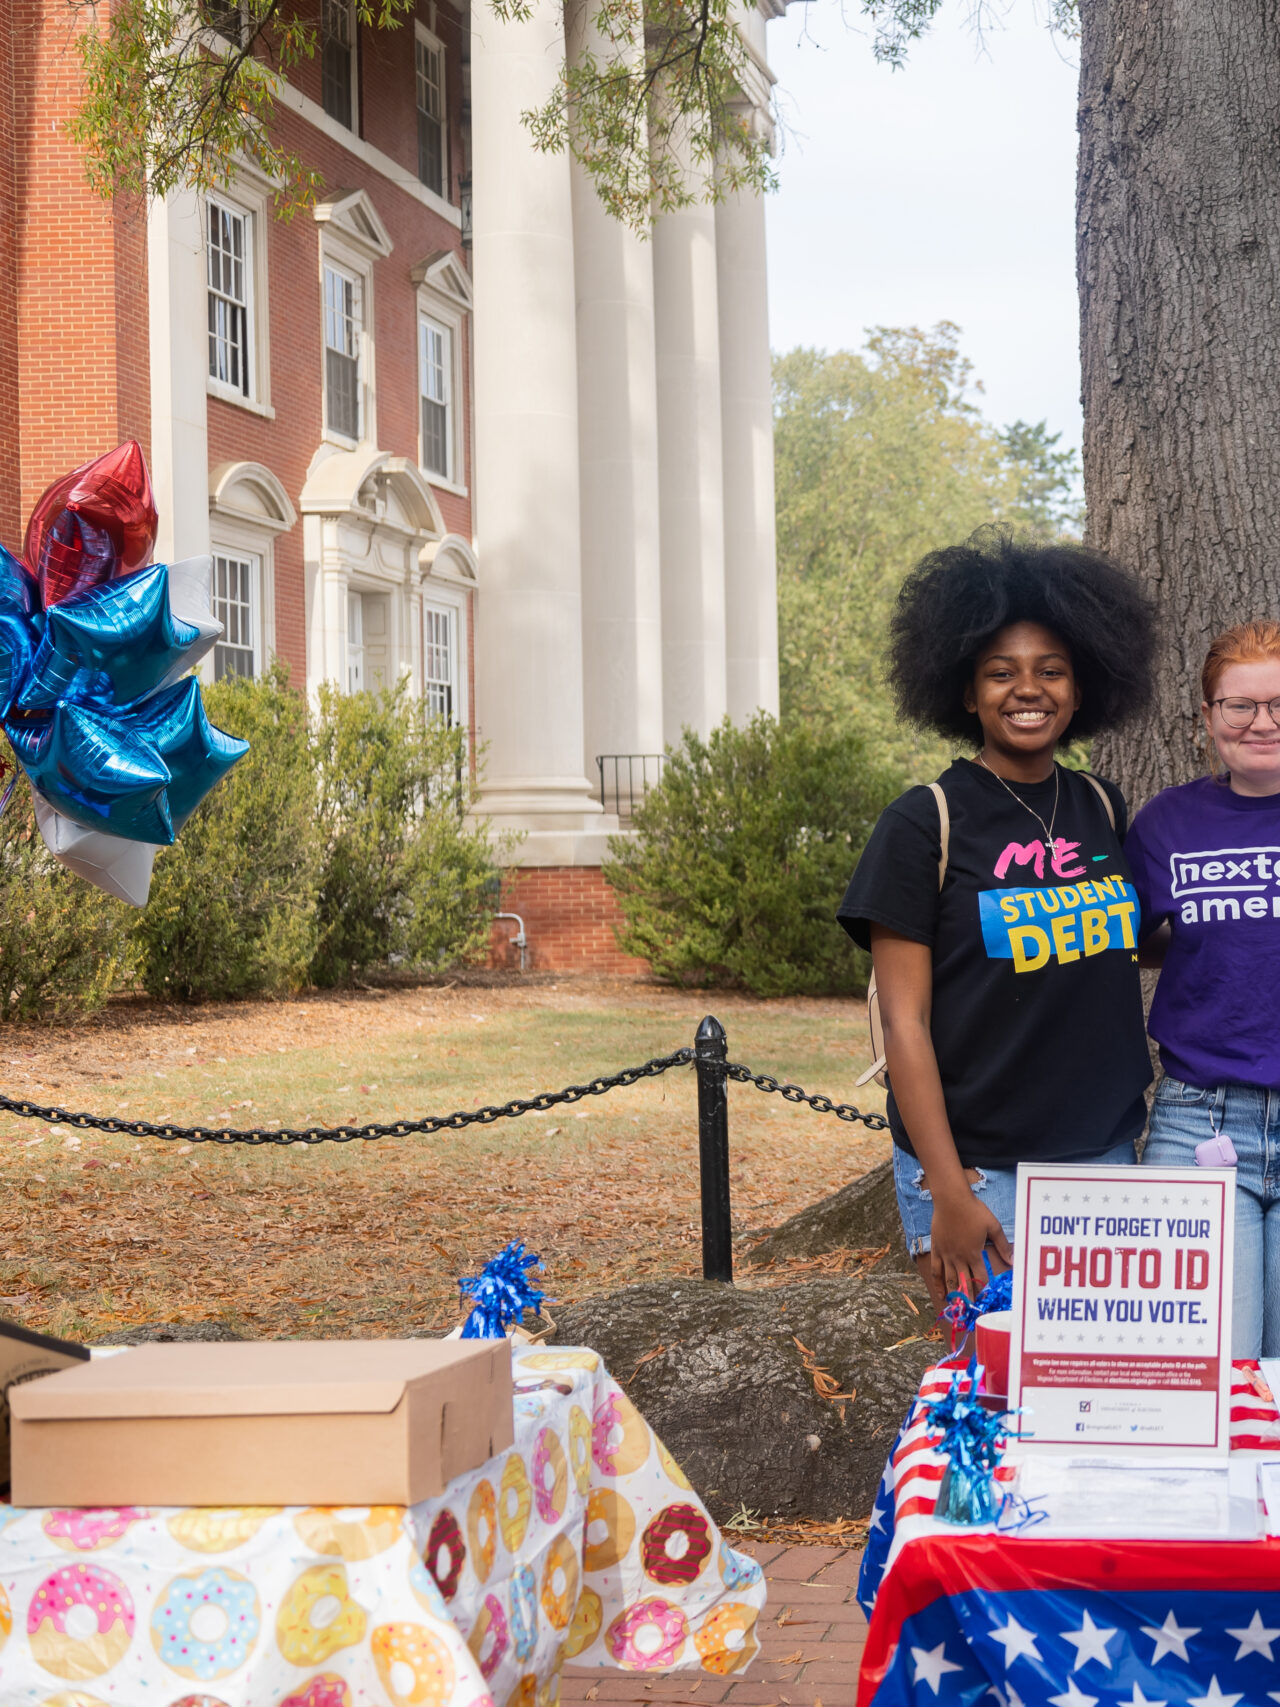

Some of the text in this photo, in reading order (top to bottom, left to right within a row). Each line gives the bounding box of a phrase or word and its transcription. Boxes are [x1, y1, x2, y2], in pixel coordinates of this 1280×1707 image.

[999, 874, 1129, 923] STUDENT
[1007, 903, 1136, 974] DEBT
[1040, 1215, 1210, 1239] DON'T FORGET YOUR
[1038, 1245, 1210, 1290] PHOTO ID
[1037, 1297, 1208, 1324] WHEN YOU VOTE.
